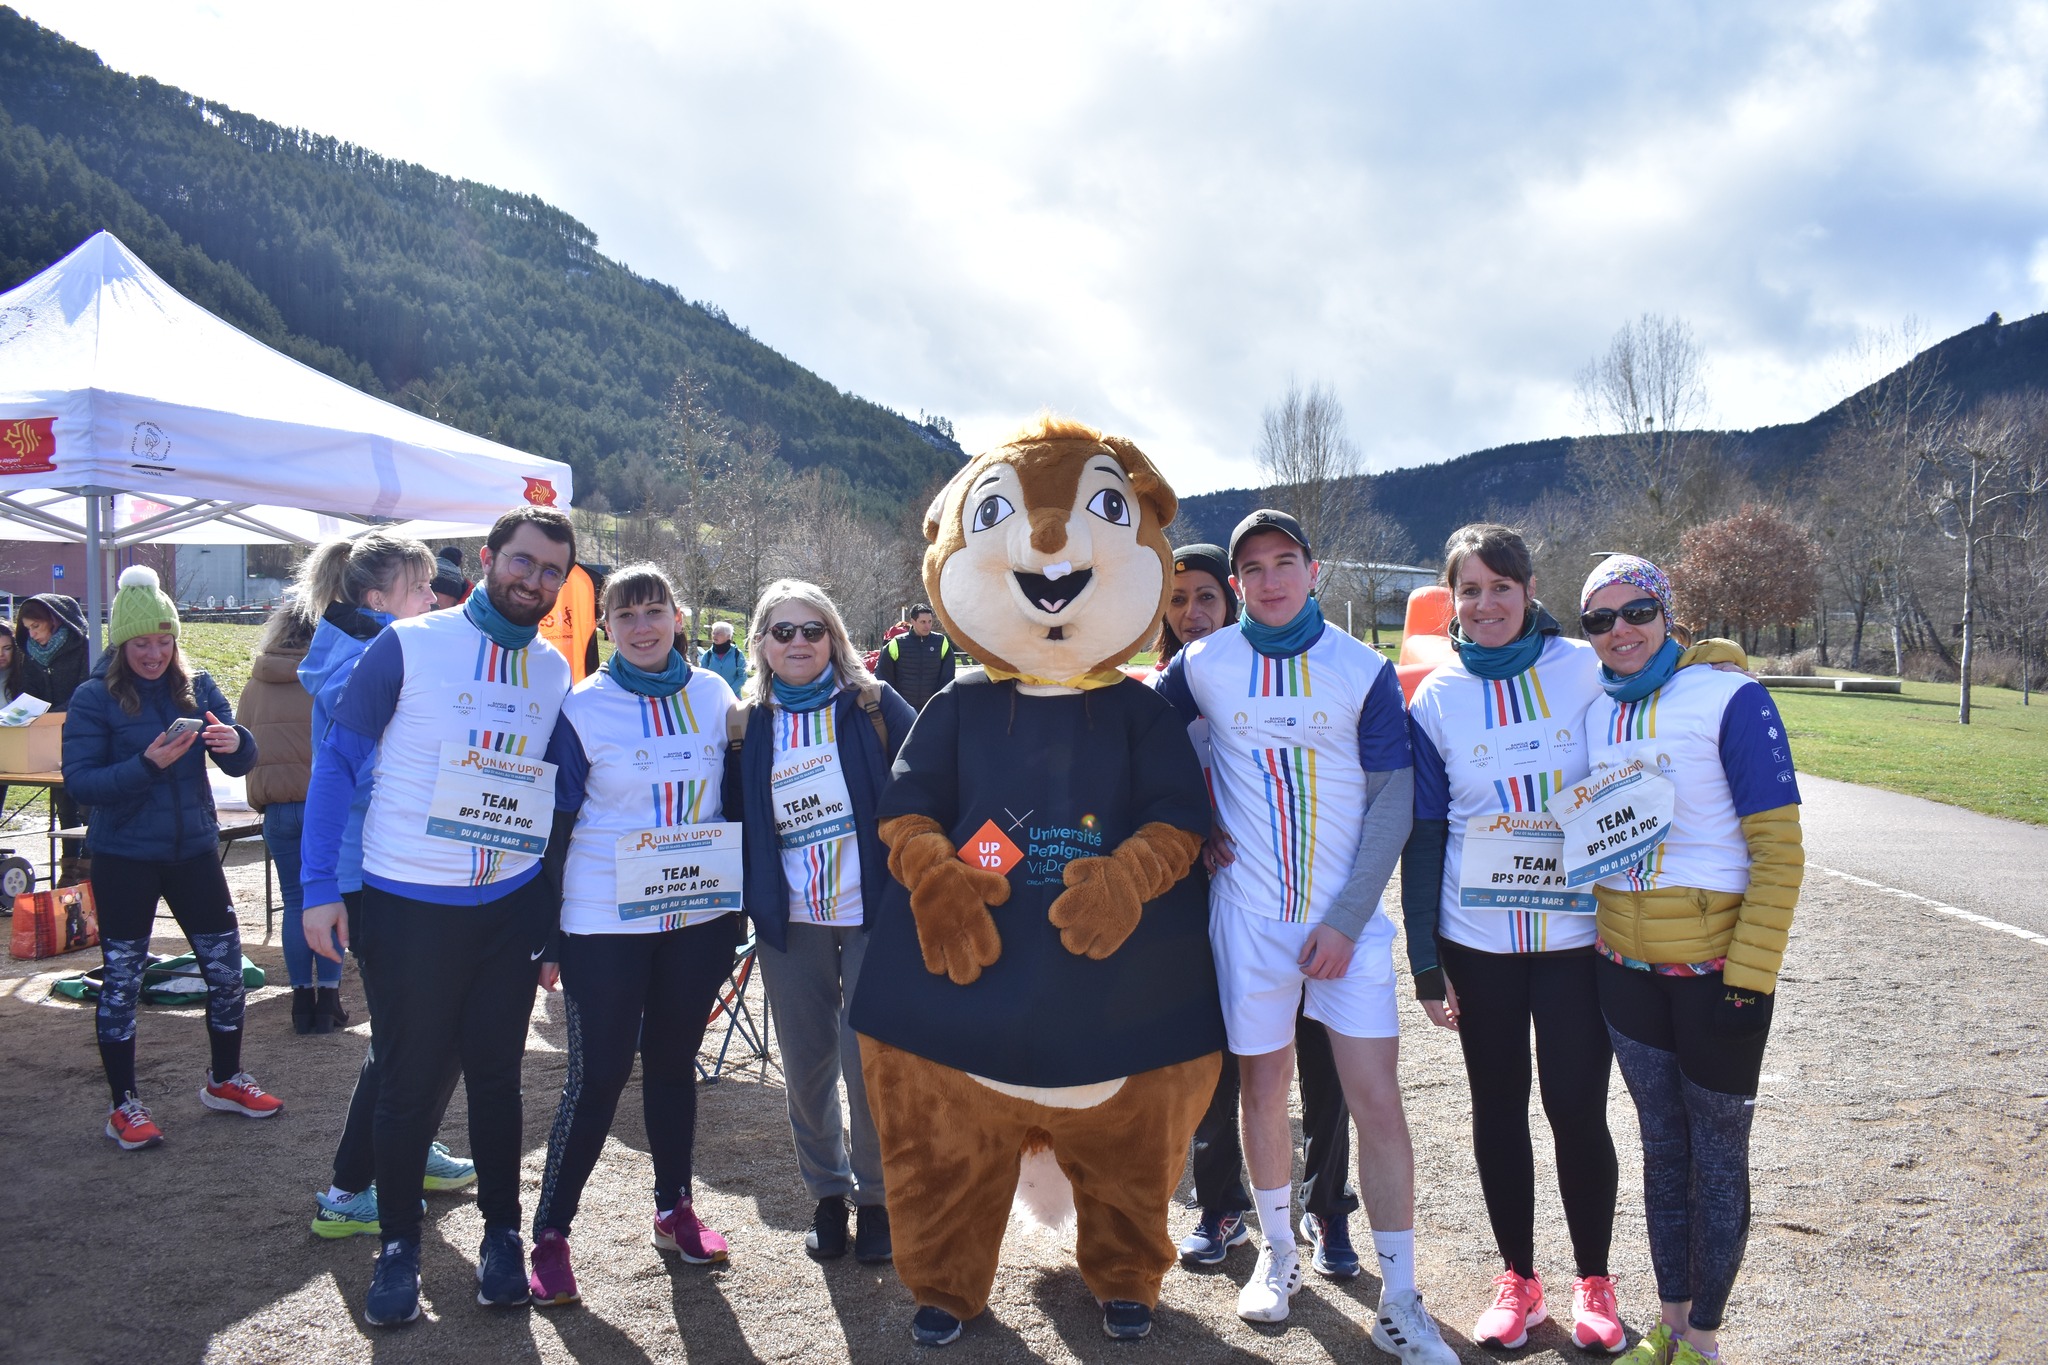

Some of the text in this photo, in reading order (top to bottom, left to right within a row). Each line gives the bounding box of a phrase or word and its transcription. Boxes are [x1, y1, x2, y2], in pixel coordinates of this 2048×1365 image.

[462, 750, 543, 777] RUN MY UPVD
[771, 754, 832, 782] UN MY UPVD
[1574, 760, 1644, 809] RUN MY UPVD
[482, 792, 518, 812] TEAM
[783, 794, 820, 815] TEAM
[459, 807, 533, 828] BPS POC A POC
[776, 802, 843, 831] BPS POC A POC
[1489, 816, 1530, 833] RUN
[1532, 821, 1553, 829] MY
[1597, 806, 1636, 833] TEAM
[461, 828, 471, 837] DU
[501, 836, 520, 846] MARS
[823, 824, 840, 835] MARS
[1029, 825, 1102, 846] Université
[1587, 816, 1658, 856] BPS POC A POC
[637, 829, 722, 850] RUN MY UPVD
[979, 842, 1000, 854] UP
[979, 855, 1002, 867] VD
[1513, 856, 1557, 871] TEAM
[1600, 863, 1610, 873] DU
[1611, 861, 1618, 869] 01
[1620, 856, 1629, 866] AU
[1631, 852, 1637, 860] 15
[662, 866, 700, 880] TEAM
[1492, 873, 1514, 883] BPS
[1517, 874, 1539, 884] POC
[1543, 876, 1551, 886] A
[645, 879, 719, 895] BPS POC A POC
[650, 904, 659, 912] DU
[1542, 897, 1564, 905] MARS
[321, 1208, 346, 1222] HOKA
